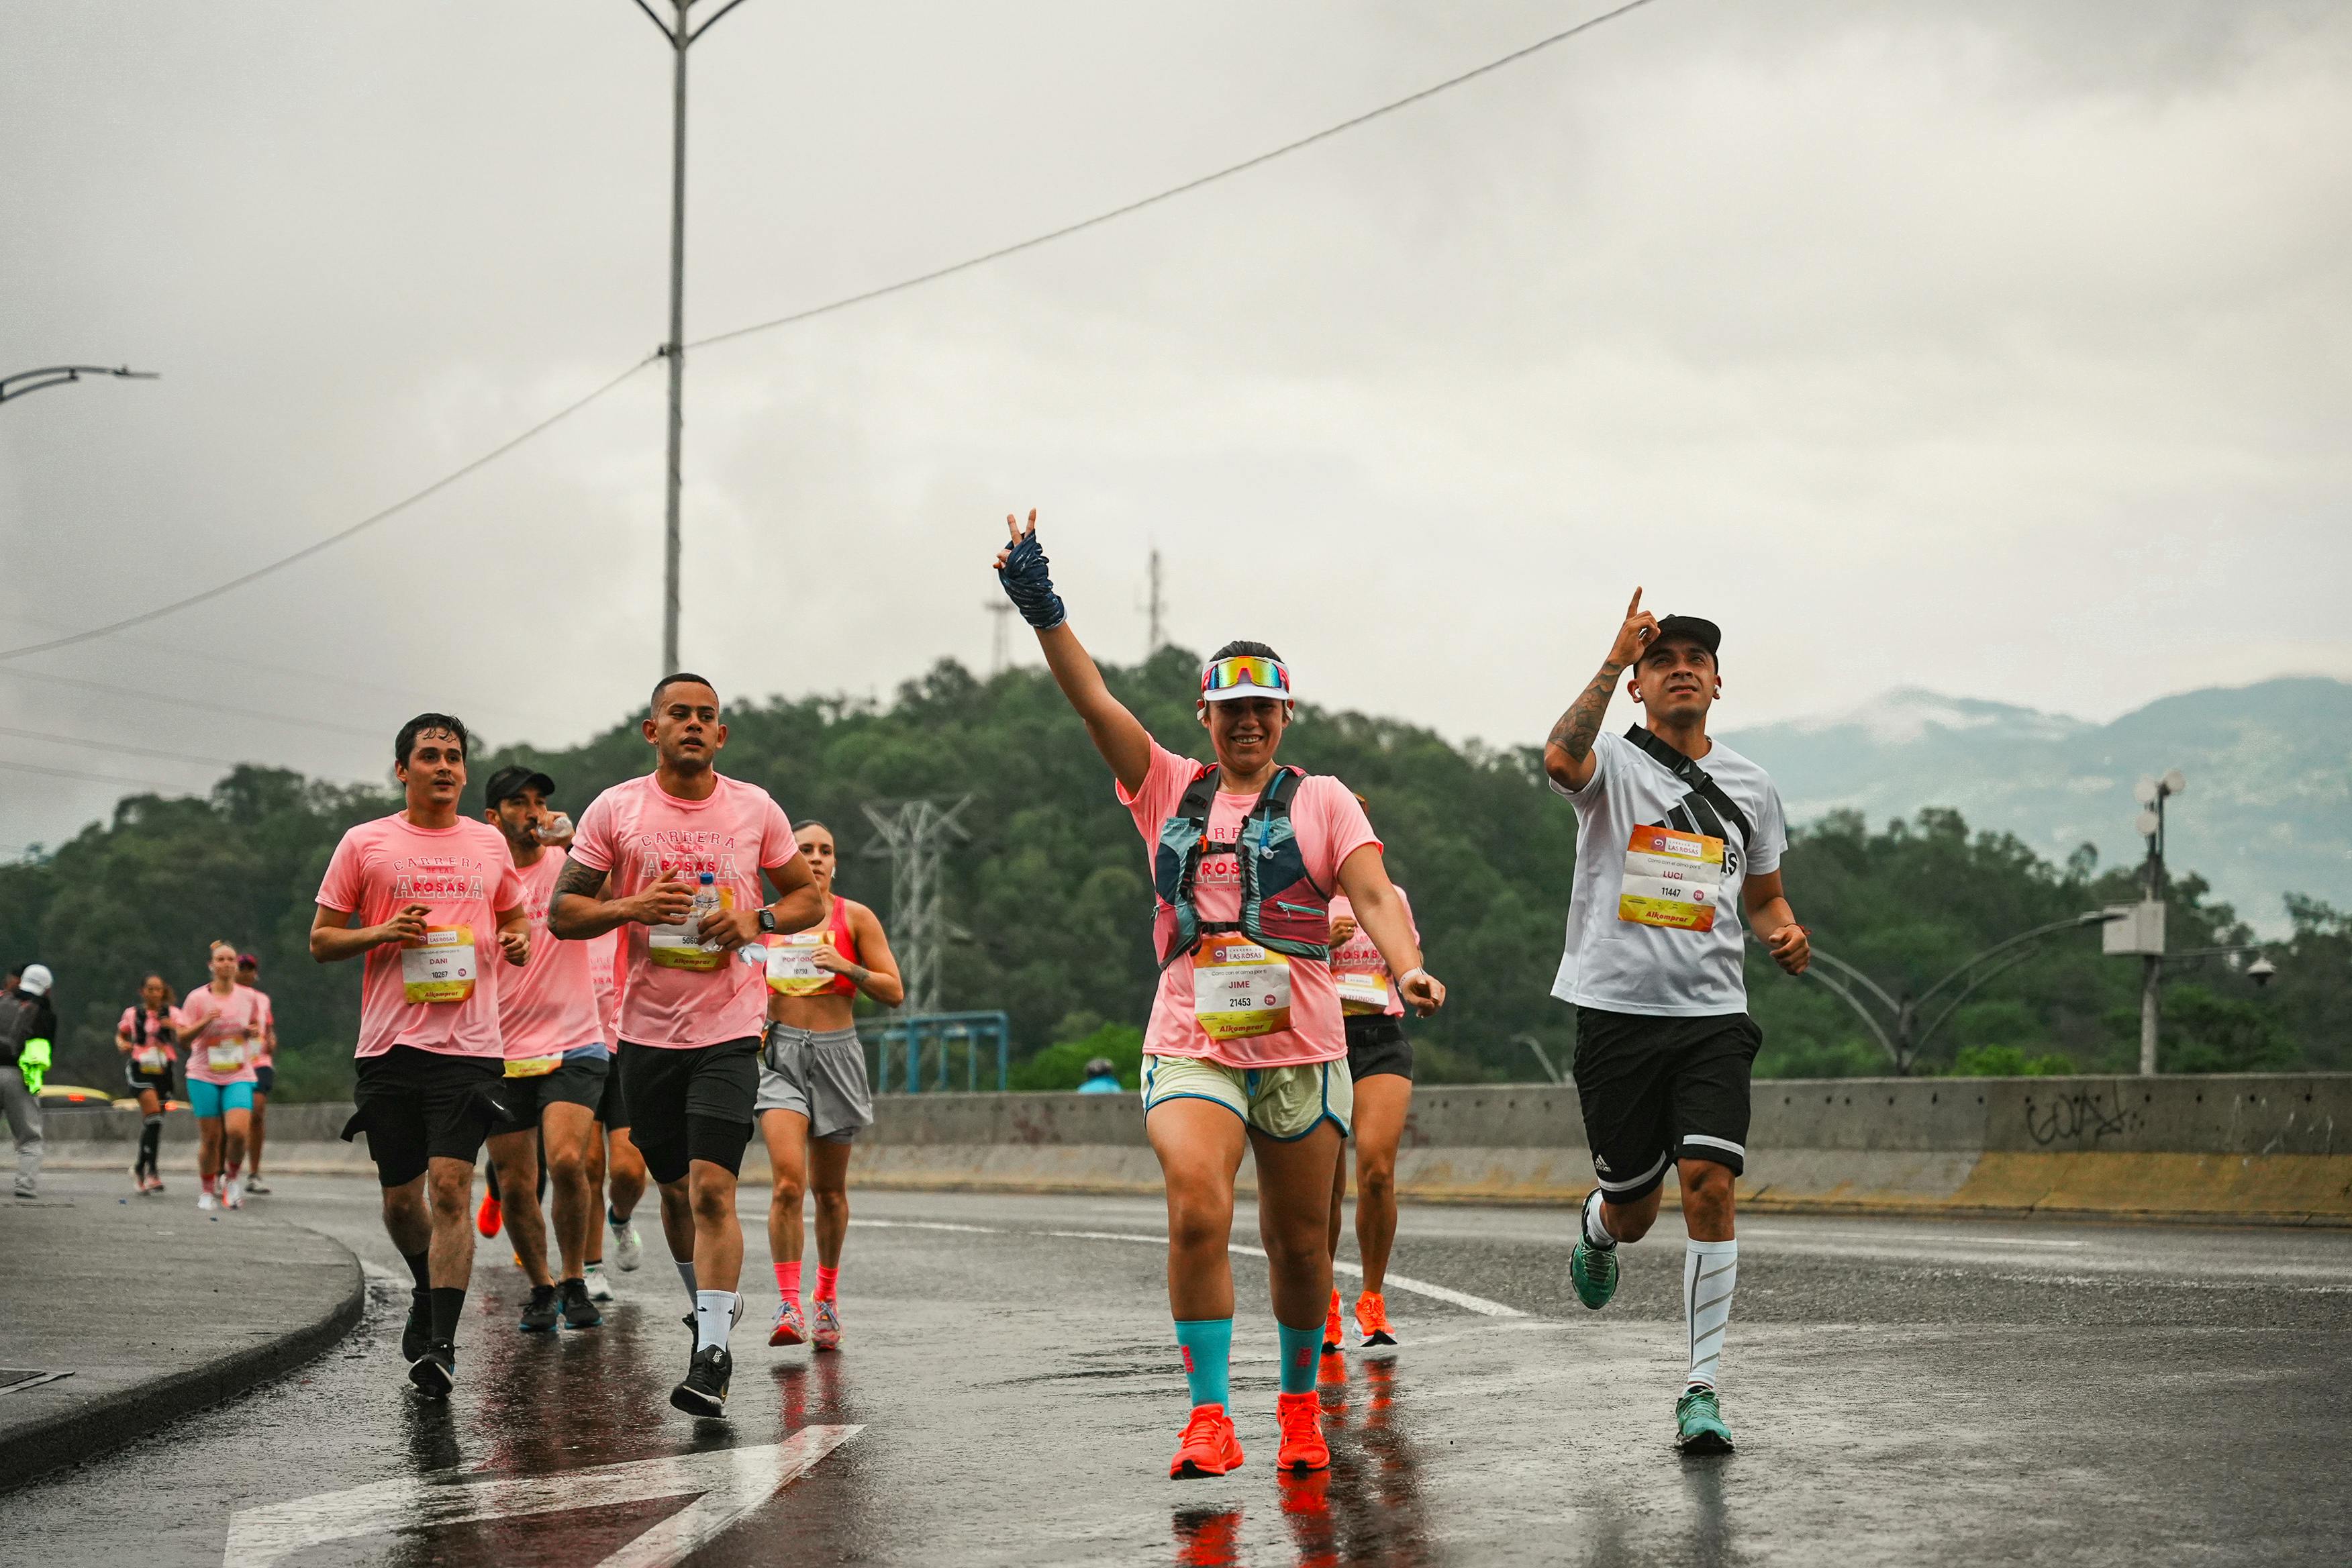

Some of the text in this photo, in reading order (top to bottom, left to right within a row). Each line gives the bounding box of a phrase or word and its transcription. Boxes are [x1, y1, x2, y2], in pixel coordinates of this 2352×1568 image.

[641, 830, 736, 849] CARRERA
[393, 856, 483, 873] CARRERA
[641, 852, 739, 879] ALMA
[661, 860, 716, 872] ROSAS
[1202, 862, 1241, 875] ROS
[1663, 871, 1683, 880] LUCI
[394, 875, 484, 899] ALMA
[413, 882, 465, 892] ROSAS
[1661, 887, 1681, 897] 11447
[1645, 911, 1688, 922] Alkomprar
[1334, 950, 1378, 960] ROSAS
[1228, 981, 1250, 989] JIME
[1230, 998, 1251, 1007] 21453
[1220, 1024, 1264, 1033] Alkomprar
